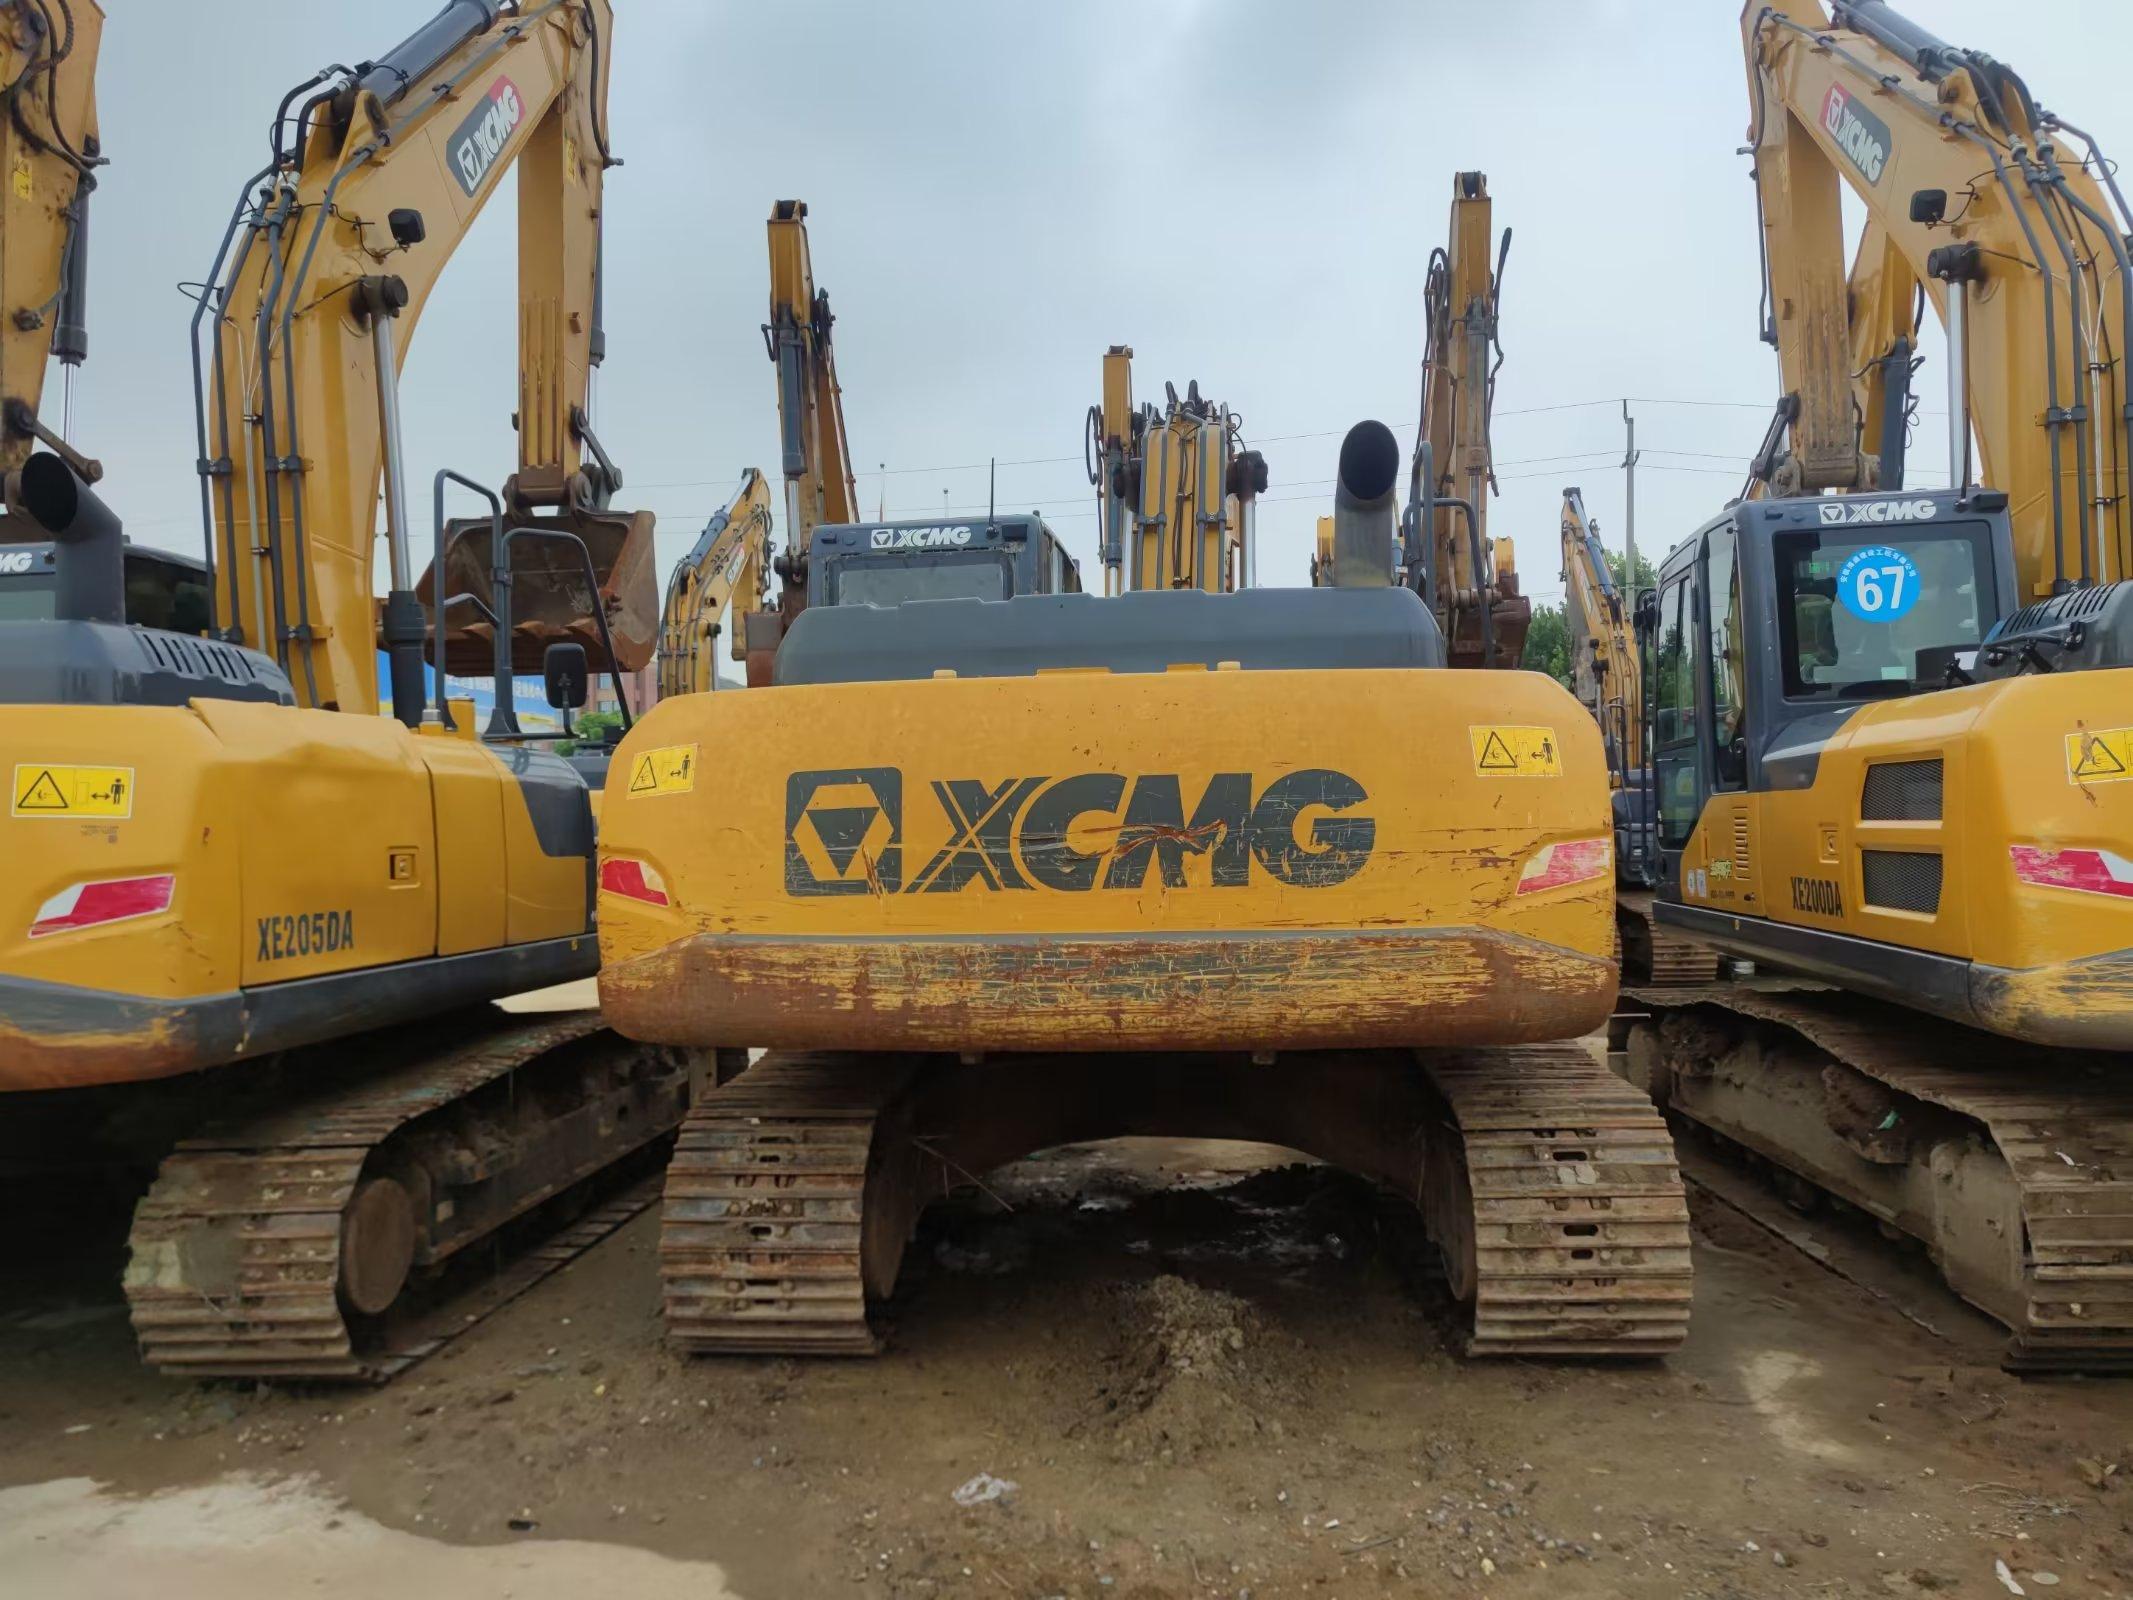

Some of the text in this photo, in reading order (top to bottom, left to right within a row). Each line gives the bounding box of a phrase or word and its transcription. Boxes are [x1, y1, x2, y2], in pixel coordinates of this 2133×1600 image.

[473, 85, 520, 173] XCMG
[1836, 106, 1883, 182] XCMG
[1846, 500, 1937, 522] XCMG
[893, 526, 972, 547] XCMG
[1856, 565, 1905, 612] 67
[903, 769, 1376, 893] XCMG
[1791, 876, 1844, 918] XE200DA
[257, 909, 354, 962] XE205DA
